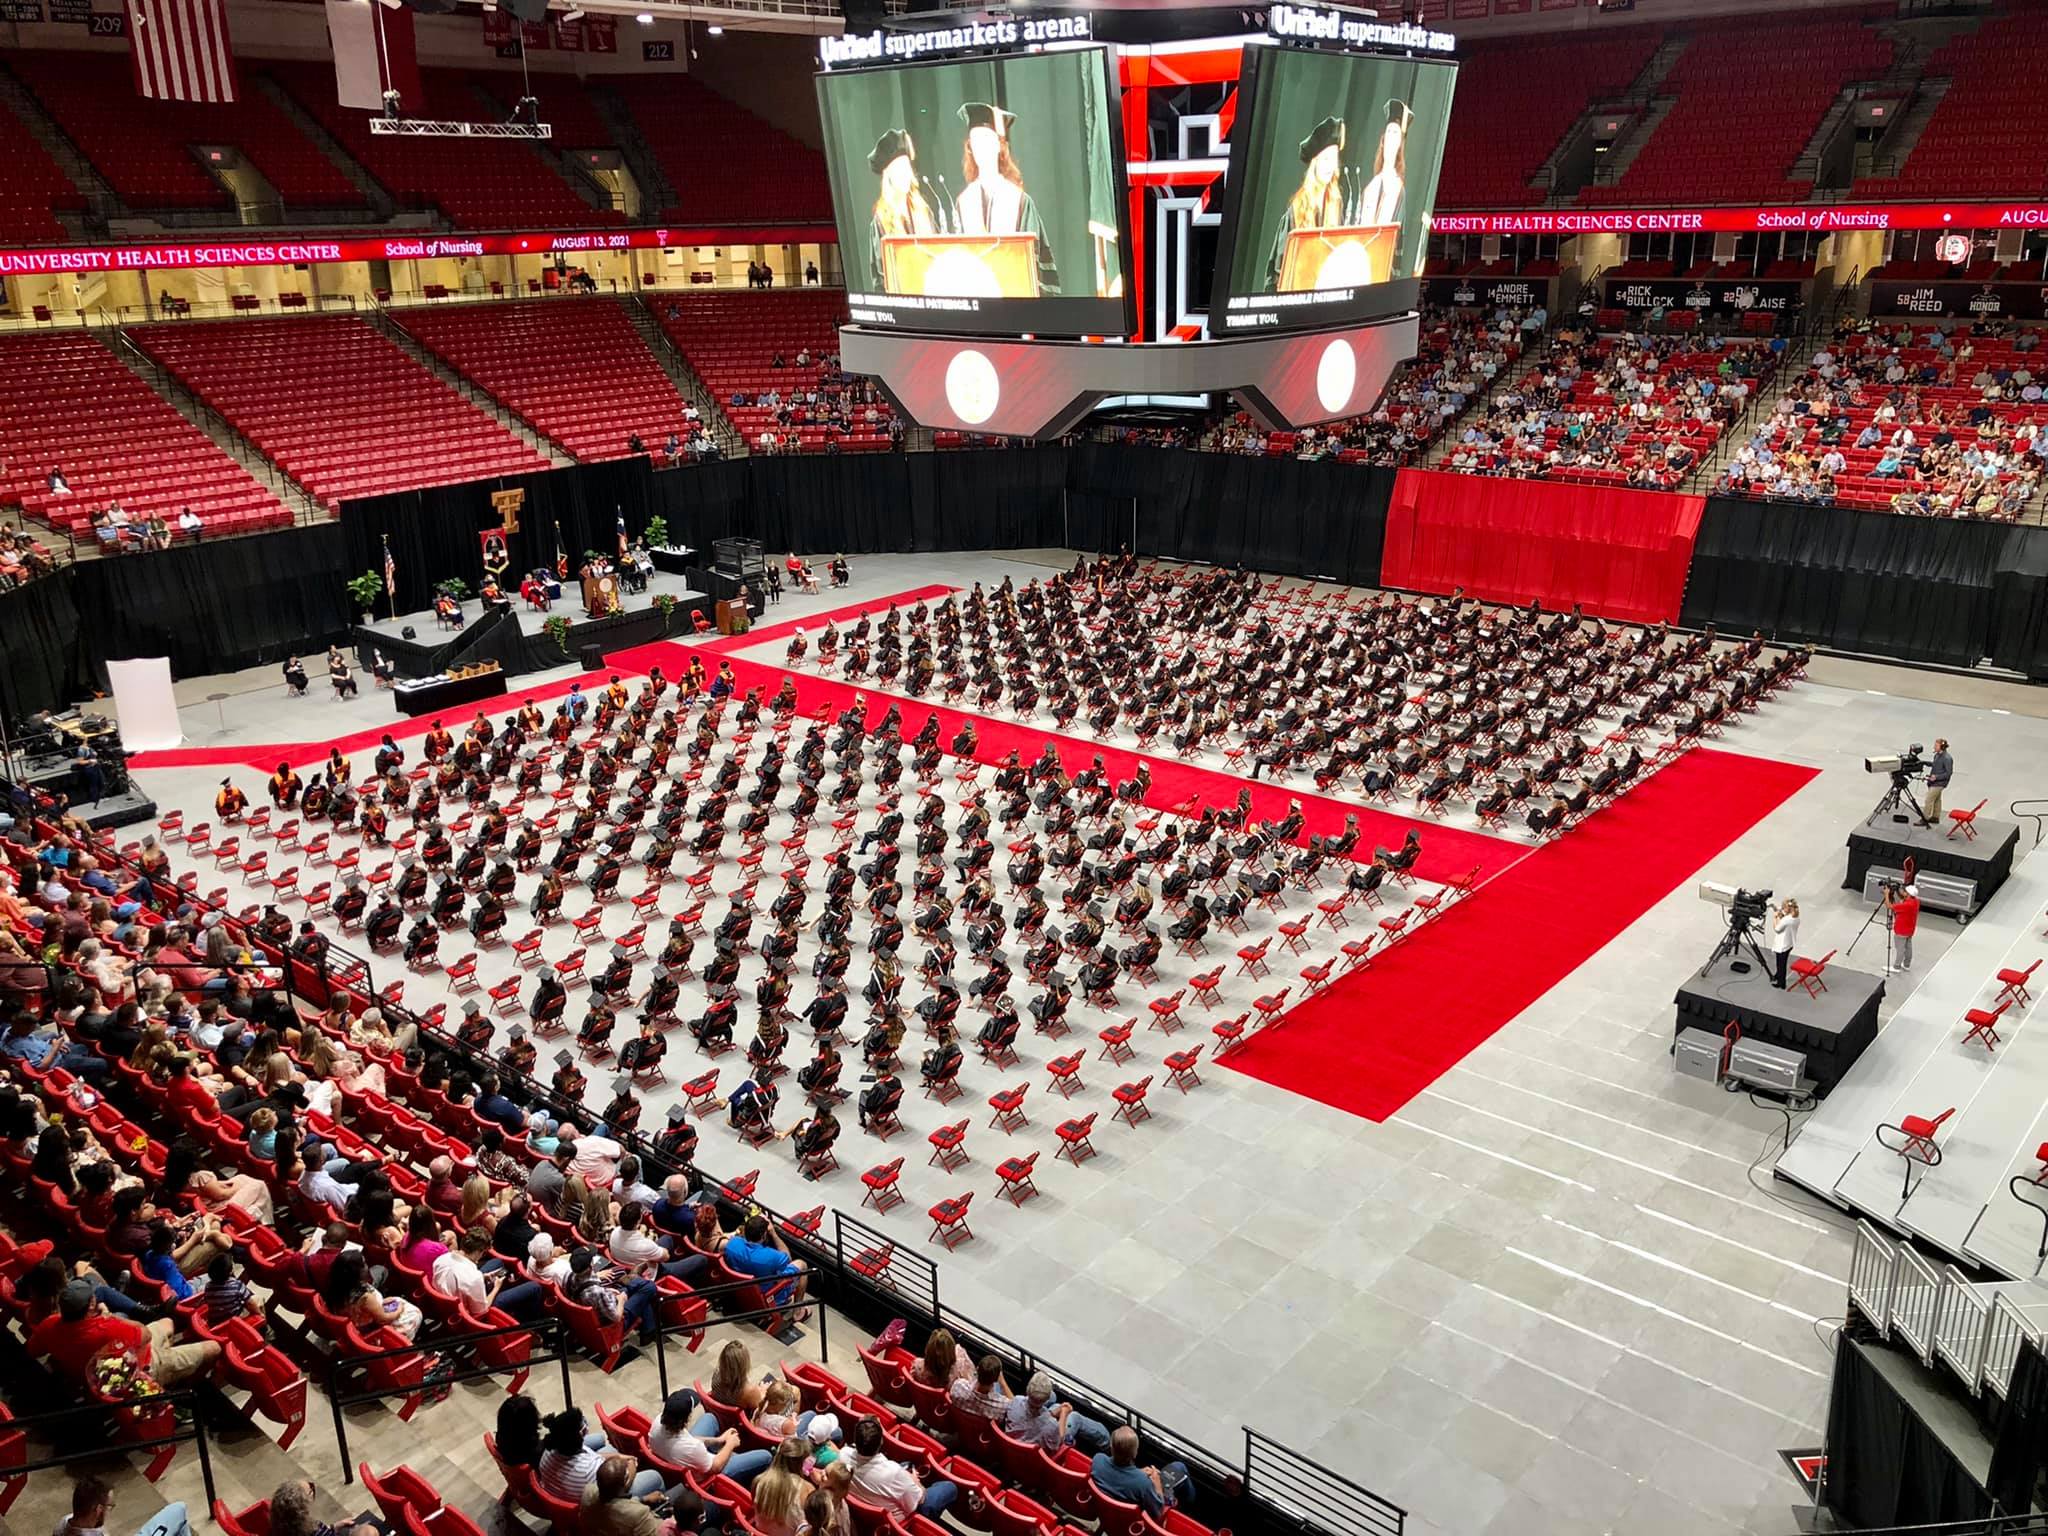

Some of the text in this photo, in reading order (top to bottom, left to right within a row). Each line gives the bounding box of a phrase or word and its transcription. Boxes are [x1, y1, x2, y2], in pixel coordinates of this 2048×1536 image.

[93, 16, 121, 33] 209
[1273, 5, 1456, 51] United supermarkets arena
[820, 16, 1090, 63] United supermarkets arena
[649, 44, 668, 58] 212
[1492, 215, 1553, 230] HEALTH
[1556, 214, 1634, 230] SCIENCES
[1636, 213, 1703, 229] CENTER
[1757, 210, 1889, 229] School of Nursing
[385, 240, 483, 257] School of Nursing
[552, 236, 591, 249] AUGUST
[609, 235, 630, 247] 2021
[0, 245, 342, 271] UNIVERSITY HEALTH SCIENCES CENTER
[1497, 284, 1529, 294] ANDRE
[1627, 286, 1652, 297] RICK
[1911, 288, 1934, 300] JIM
[1495, 294, 1535, 304] EMMETT
[1616, 290, 1627, 302] 54
[1723, 292, 1735, 303] 22
[1897, 293, 1910, 305] 58
[1909, 300, 1943, 312] REED
[1969, 301, 2001, 313] HONOR
